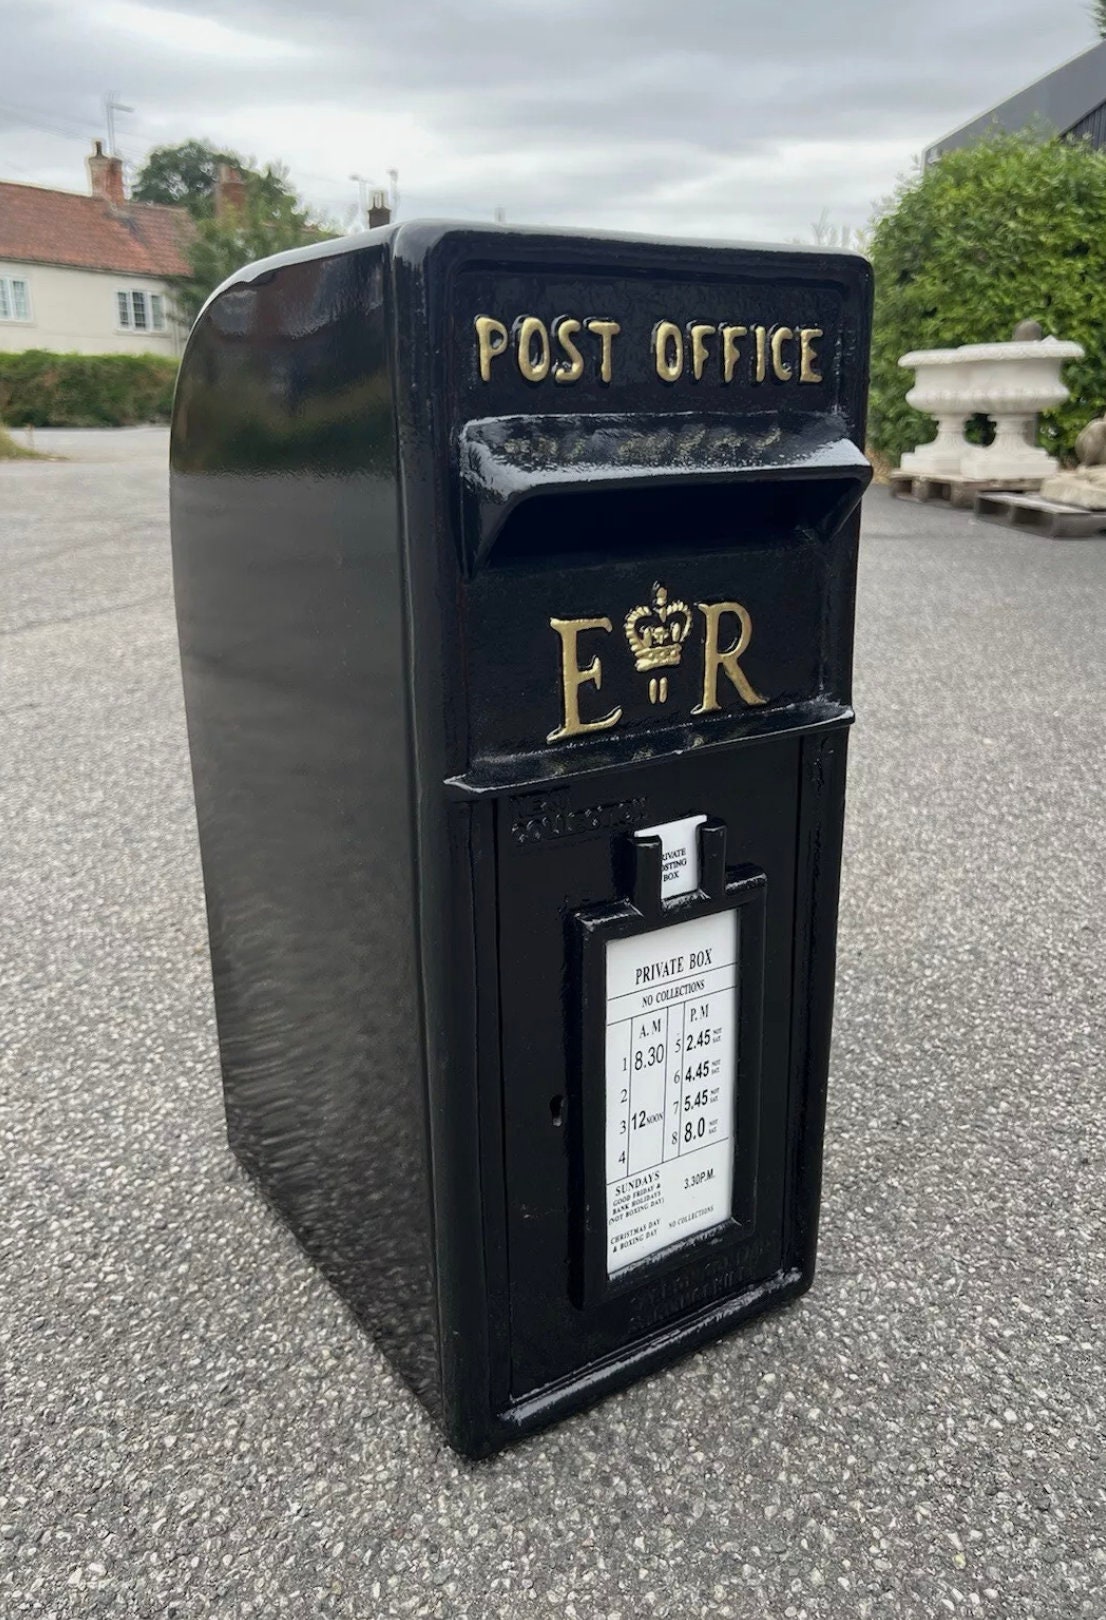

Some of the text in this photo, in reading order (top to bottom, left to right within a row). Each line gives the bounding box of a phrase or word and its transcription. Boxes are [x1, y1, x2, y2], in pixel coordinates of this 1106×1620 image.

[475, 316, 823, 384] POST OFFICE
[547, 601, 767, 744] E R
[661, 848, 687, 861] RIVATE
[661, 858, 687, 872] OSTING
[663, 871, 680, 882] BOX
[635, 948, 713, 985] PRIVATE BOX
[642, 980, 706, 1008] NO COLLECTIONS
[674, 1028, 711, 1054] 5 2.45
[622, 1043, 665, 1072] 1 8.30
[673, 1060, 710, 1085] 6 4.45
[620, 1088, 628, 1104] 2
[673, 1089, 709, 1115] 7 5.45
[619, 1120, 627, 1135] 3
[671, 1117, 706, 1145] 8 8.0
[618, 1150, 626, 1165] 4
[615, 1170, 661, 1197] SUNDAYS
[612, 1191, 662, 1215] BANK HOLIDAYS
[613, 1194, 631, 1207] GOOD
[632, 1186, 654, 1199] FRIDAY
[625, 1205, 649, 1218] BOXING
[668, 1205, 714, 1228] NO COLLECTIONS
[610, 1219, 661, 1245] CHRISTMAS DAY
[612, 1229, 658, 1253] & BOXING DAY
